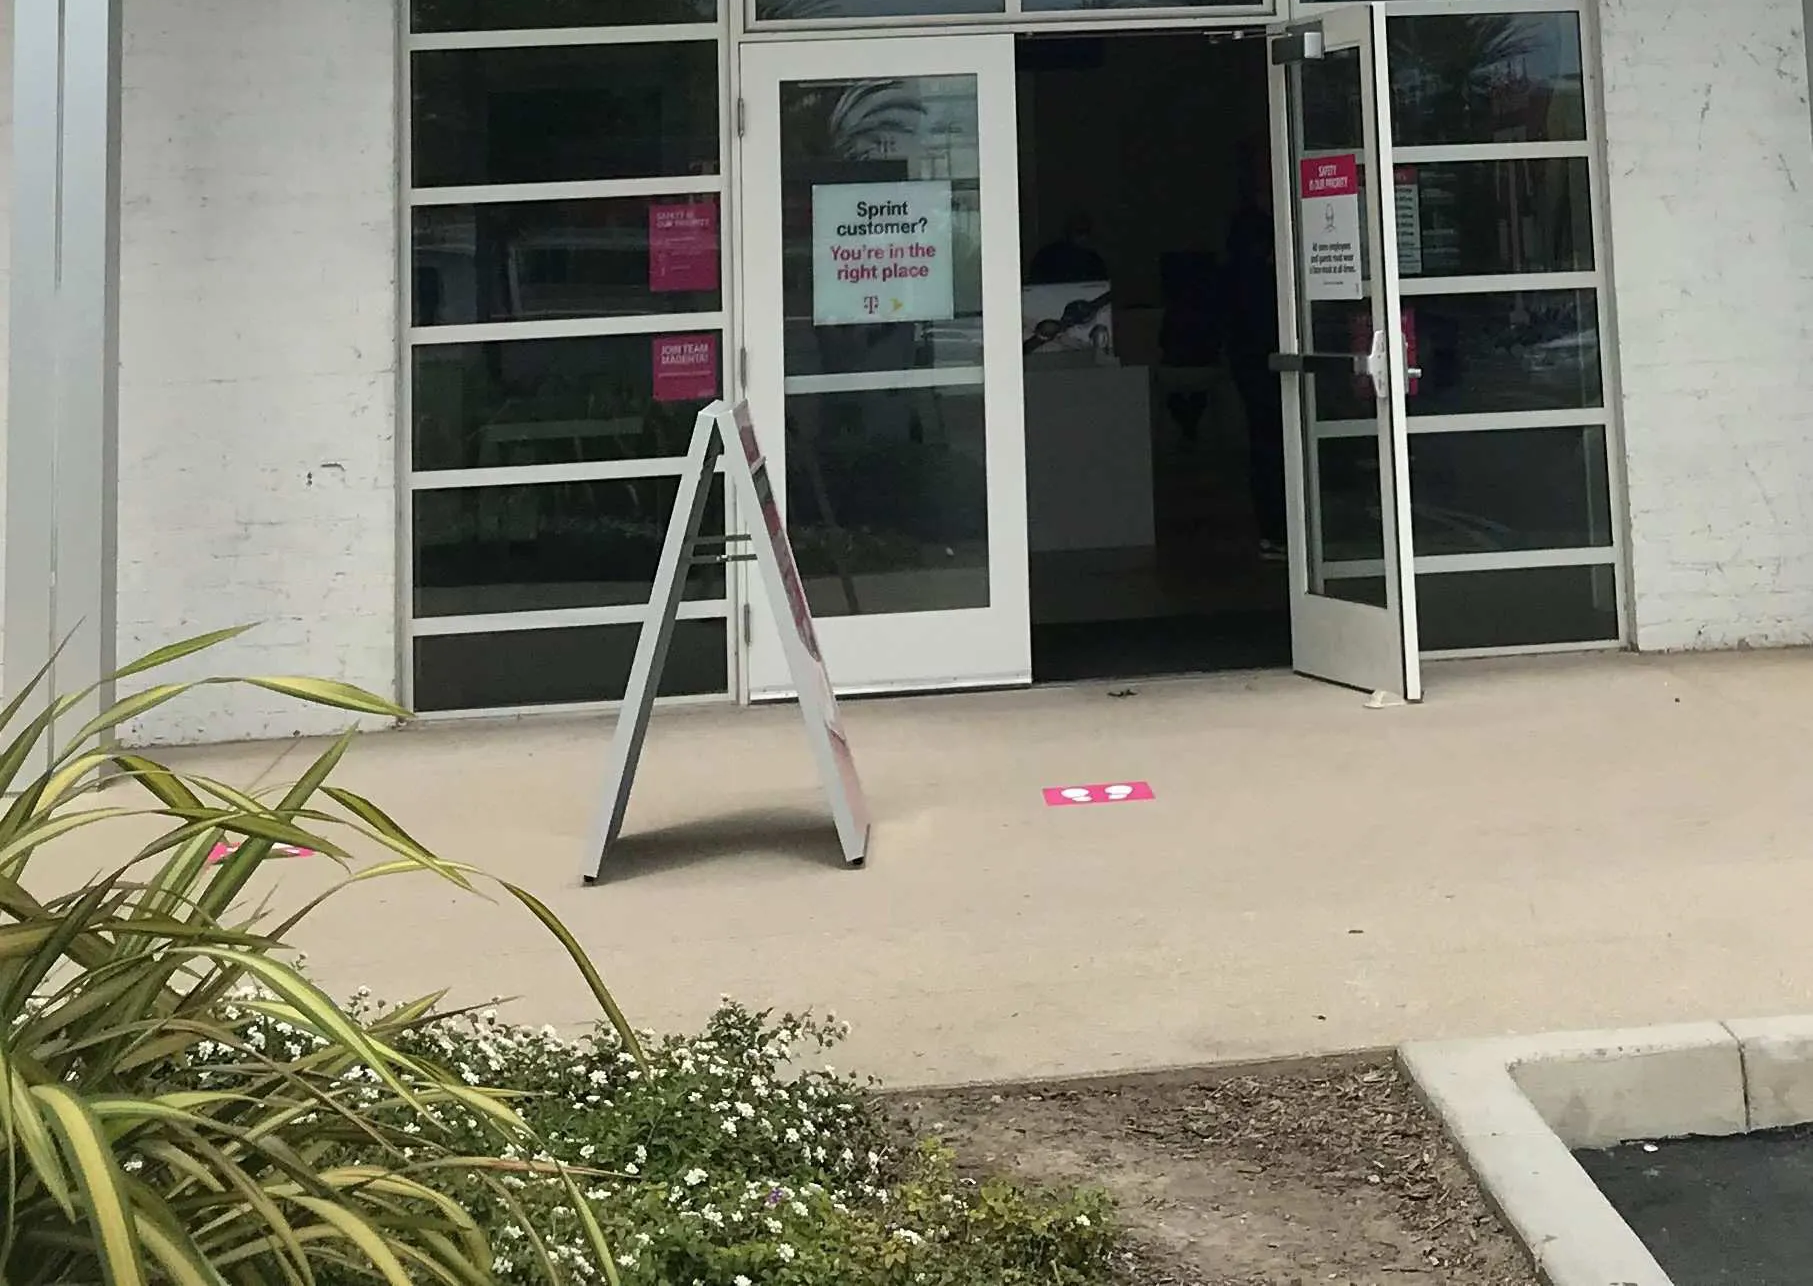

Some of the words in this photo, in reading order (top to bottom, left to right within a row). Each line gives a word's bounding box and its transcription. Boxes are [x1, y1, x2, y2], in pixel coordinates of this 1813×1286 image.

[1318, 164, 1337, 177] SAFETY
[1326, 176, 1348, 189] PRIORITY
[857, 201, 908, 219] Sprint
[836, 217, 928, 236] customer?
[831, 244, 884, 261] You're
[889, 244, 904, 259] in
[909, 242, 936, 258] the
[837, 265, 878, 283] right
[882, 263, 928, 281] place
[661, 344, 681, 355] JOIN
[683, 342, 709, 354] TEAM
